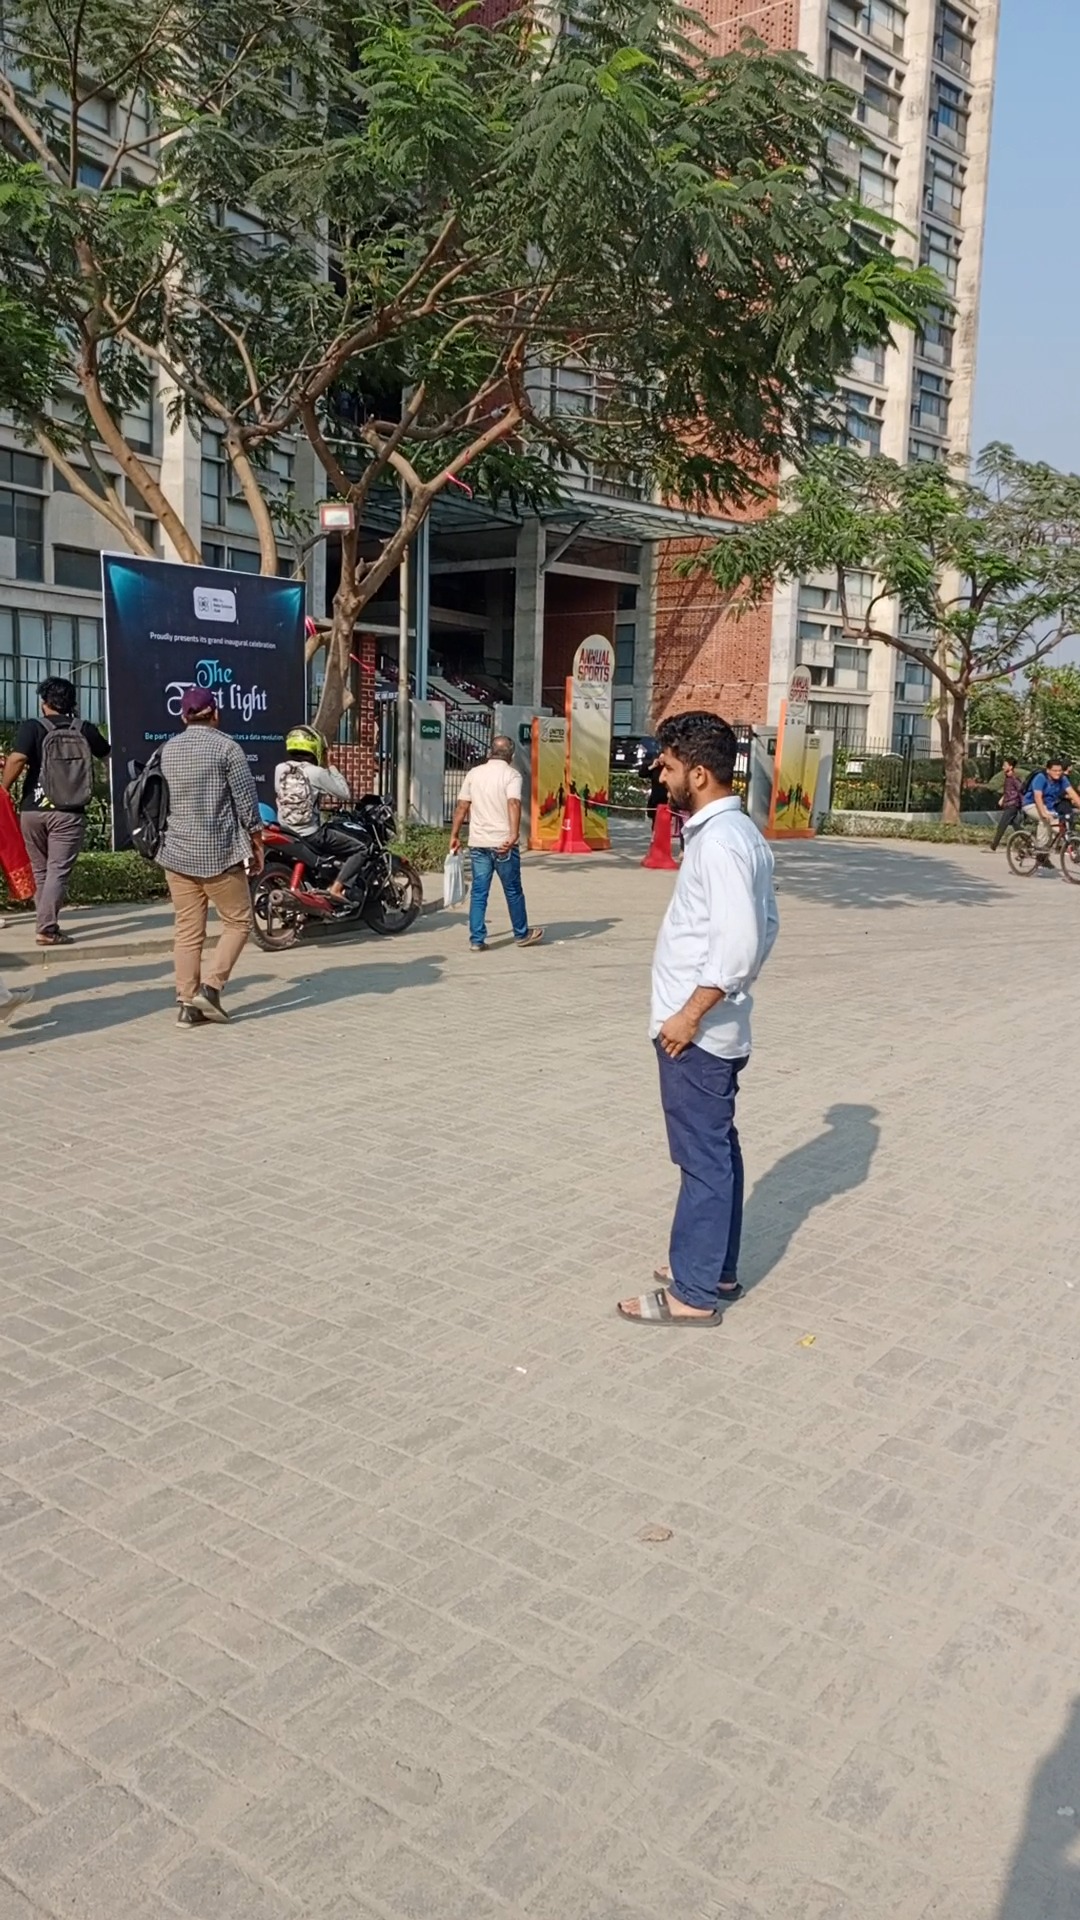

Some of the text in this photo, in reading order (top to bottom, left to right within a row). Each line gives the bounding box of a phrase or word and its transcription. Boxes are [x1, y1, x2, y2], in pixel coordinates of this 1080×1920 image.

[150, 631, 173, 642] Proudly
[174, 634, 199, 642] presents
[208, 637, 223, 645] grand
[224, 639, 248, 647] inaugural
[249, 640, 276, 648] celebration
[580, 648, 610, 665] ANNUAL
[195, 659, 232, 688] The
[578, 665, 610, 682] SPORTS
[229, 684, 267, 721] light
[144, 732, 153, 740] Be
[154, 733, 167, 741] part
[549, 728, 564, 736] UNITED
